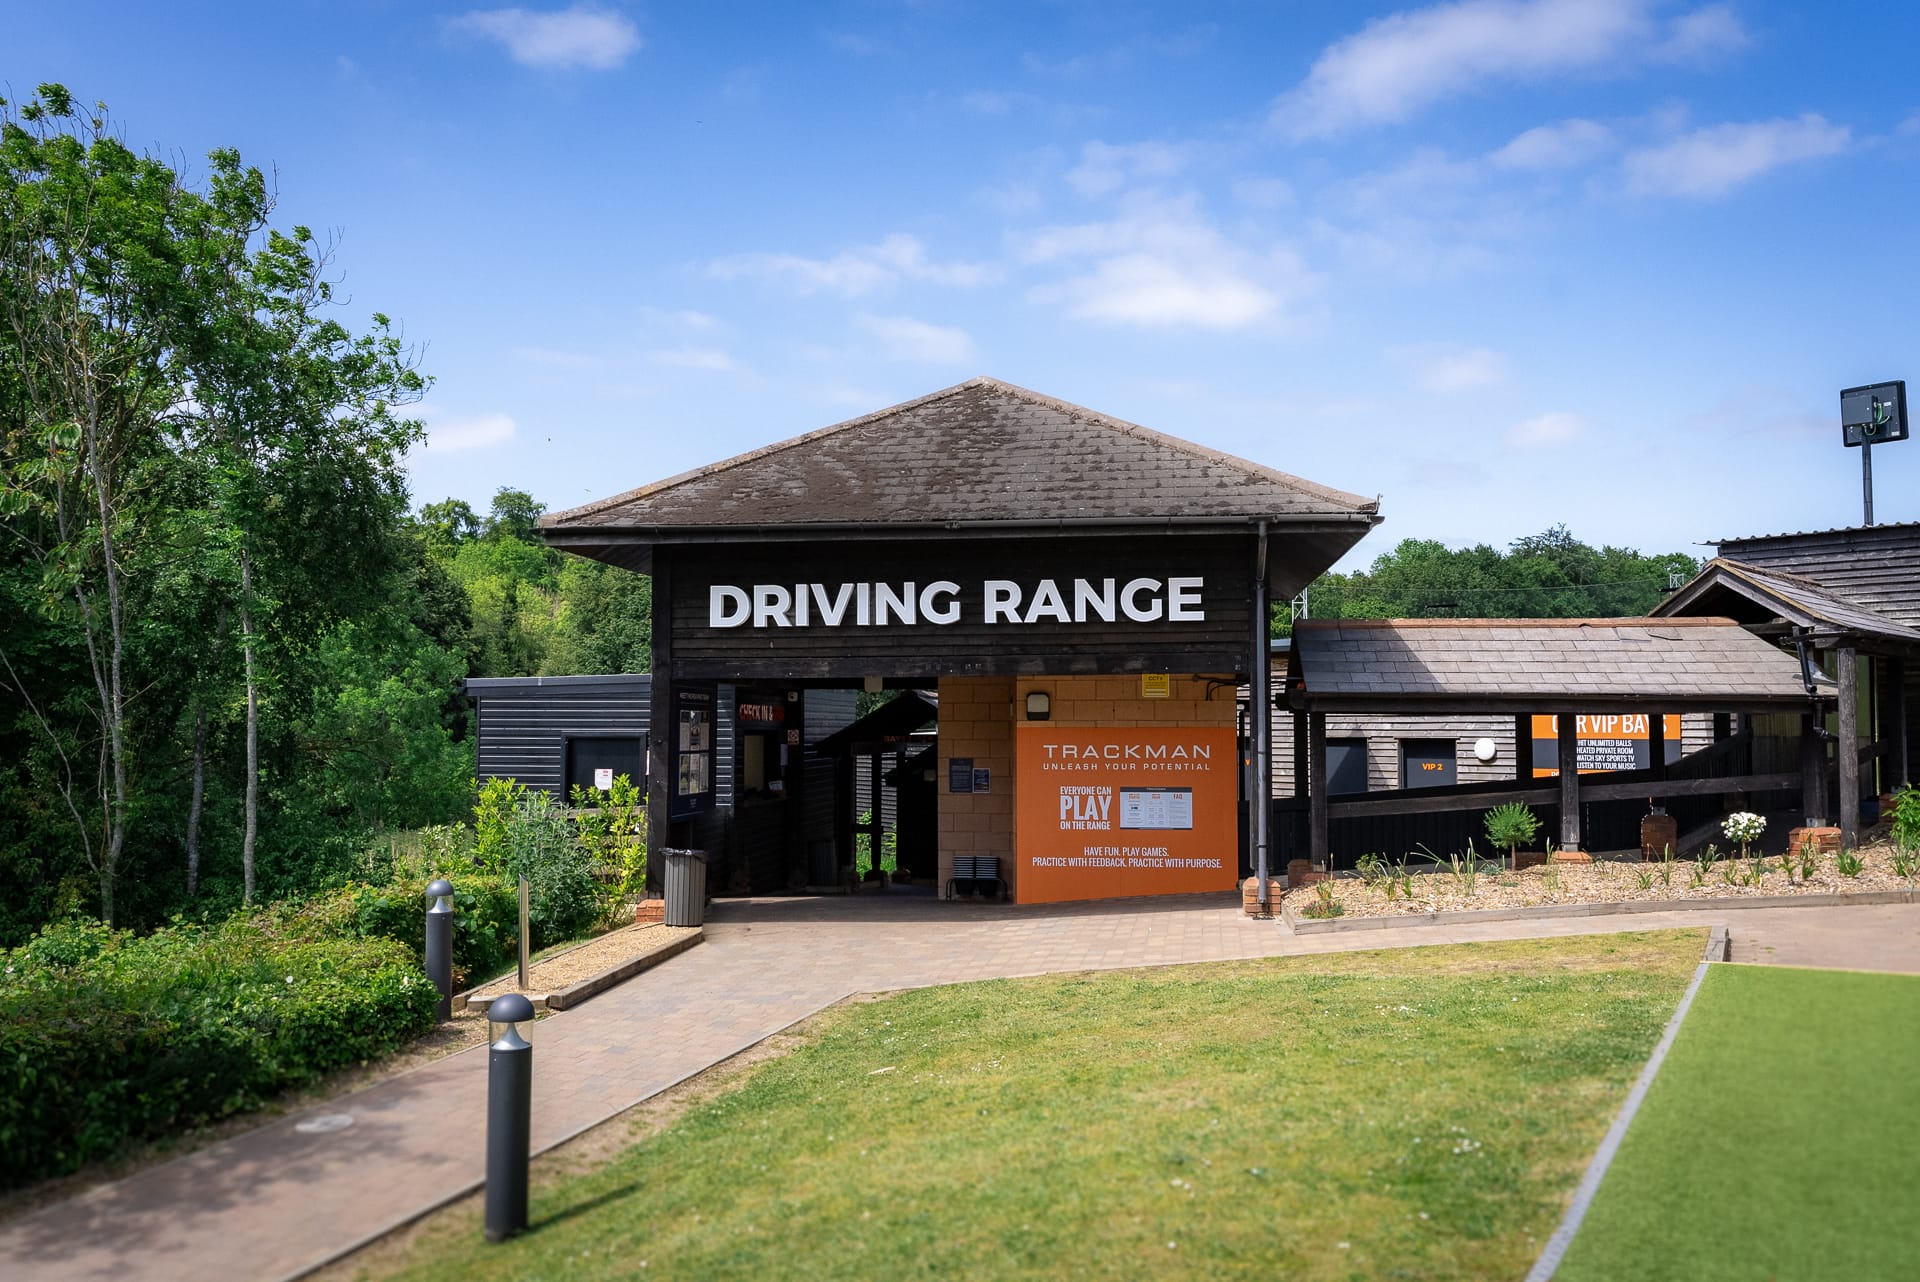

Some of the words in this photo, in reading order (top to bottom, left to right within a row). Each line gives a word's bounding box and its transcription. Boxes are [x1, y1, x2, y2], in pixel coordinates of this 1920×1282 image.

[709, 581, 961, 628] DRIVING
[984, 577, 1205, 623] RANGE
[761, 704, 768, 720] IN
[769, 704, 774, 721] &
[1552, 714, 1587, 733] OR
[1590, 714, 1618, 733] VIP
[1042, 744, 1211, 759] TRACKMAN
[1576, 754, 1594, 762] WATCH
[1043, 763, 1099, 771] UNLEASH
[1105, 763, 1137, 771] YOUR
[1143, 763, 1211, 771] POTENTIAL
[1422, 763, 1436, 771] VIP
[1437, 763, 1443, 771] 2
[1618, 762, 1636, 770] MUSIC
[1060, 786, 1096, 795] EVERYONE
[1097, 786, 1112, 795] CAN
[1060, 795, 1112, 820] PLAY
[1060, 821, 1071, 830] ON
[1072, 821, 1086, 830] THE
[1087, 821, 1111, 830] RANGE
[1084, 847, 1103, 856] HAVE
[1104, 847, 1120, 856] FUN.
[1122, 847, 1140, 856] PLAY
[1142, 847, 1169, 857] GAMES.
[1032, 857, 1067, 867] PRACTICE
[1068, 857, 1087, 867] WITH
[1088, 858, 1127, 868] FEEDBACK.
[1128, 858, 1163, 868] PRACTICE
[1165, 858, 1184, 868] WITH
[1185, 859, 1223, 869] PURPOSE.
